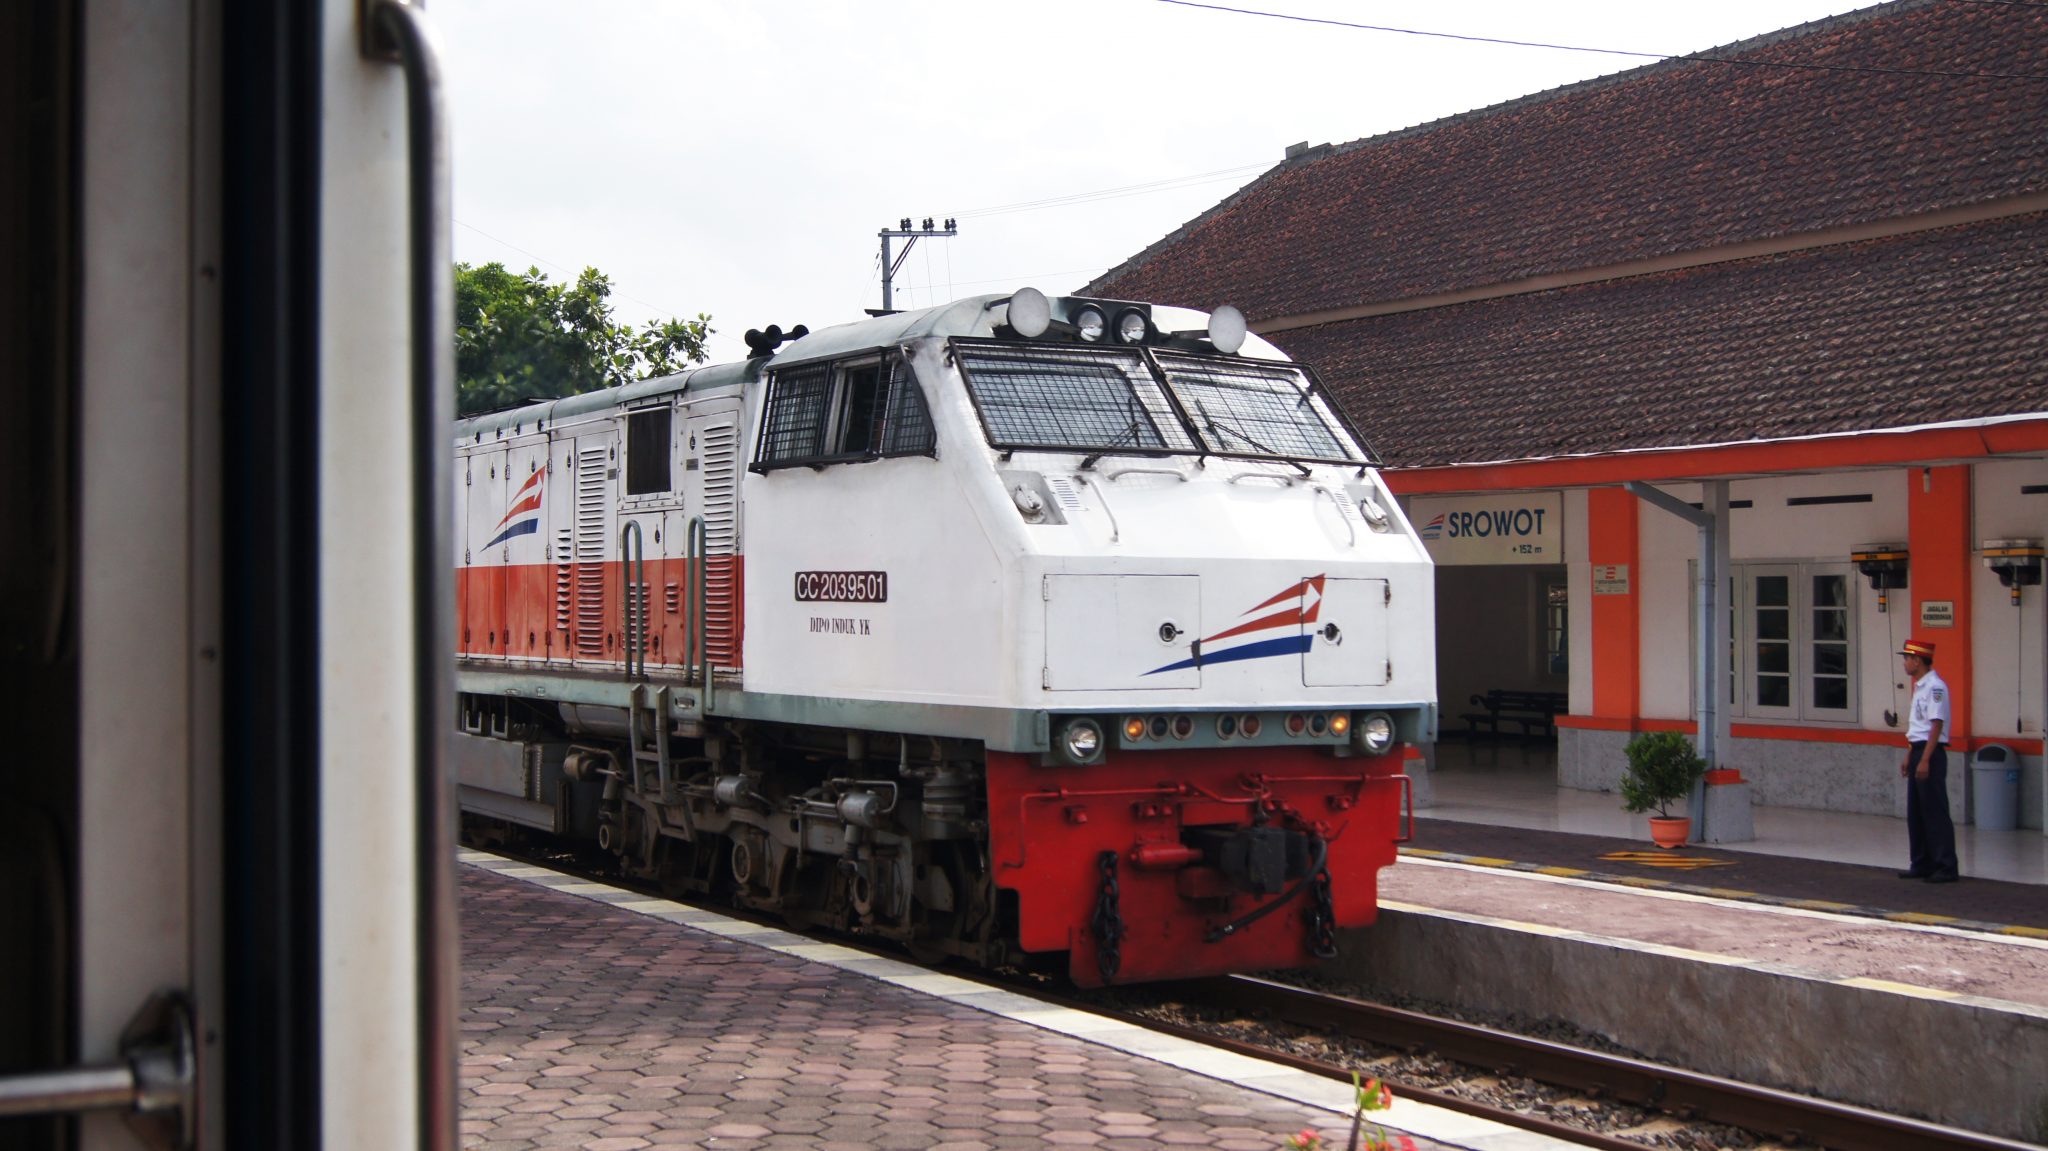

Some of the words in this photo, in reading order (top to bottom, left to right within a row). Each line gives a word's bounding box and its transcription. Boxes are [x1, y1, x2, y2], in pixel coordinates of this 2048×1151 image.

[1448, 508, 1545, 538] SROWOT
[1519, 544, 1532, 554] 152
[1534, 546, 1542, 554] m
[797, 573, 883, 600] CC2039501
[810, 617, 830, 632] DIPO
[831, 618, 856, 634] INDUK
[859, 619, 870, 635] YK
